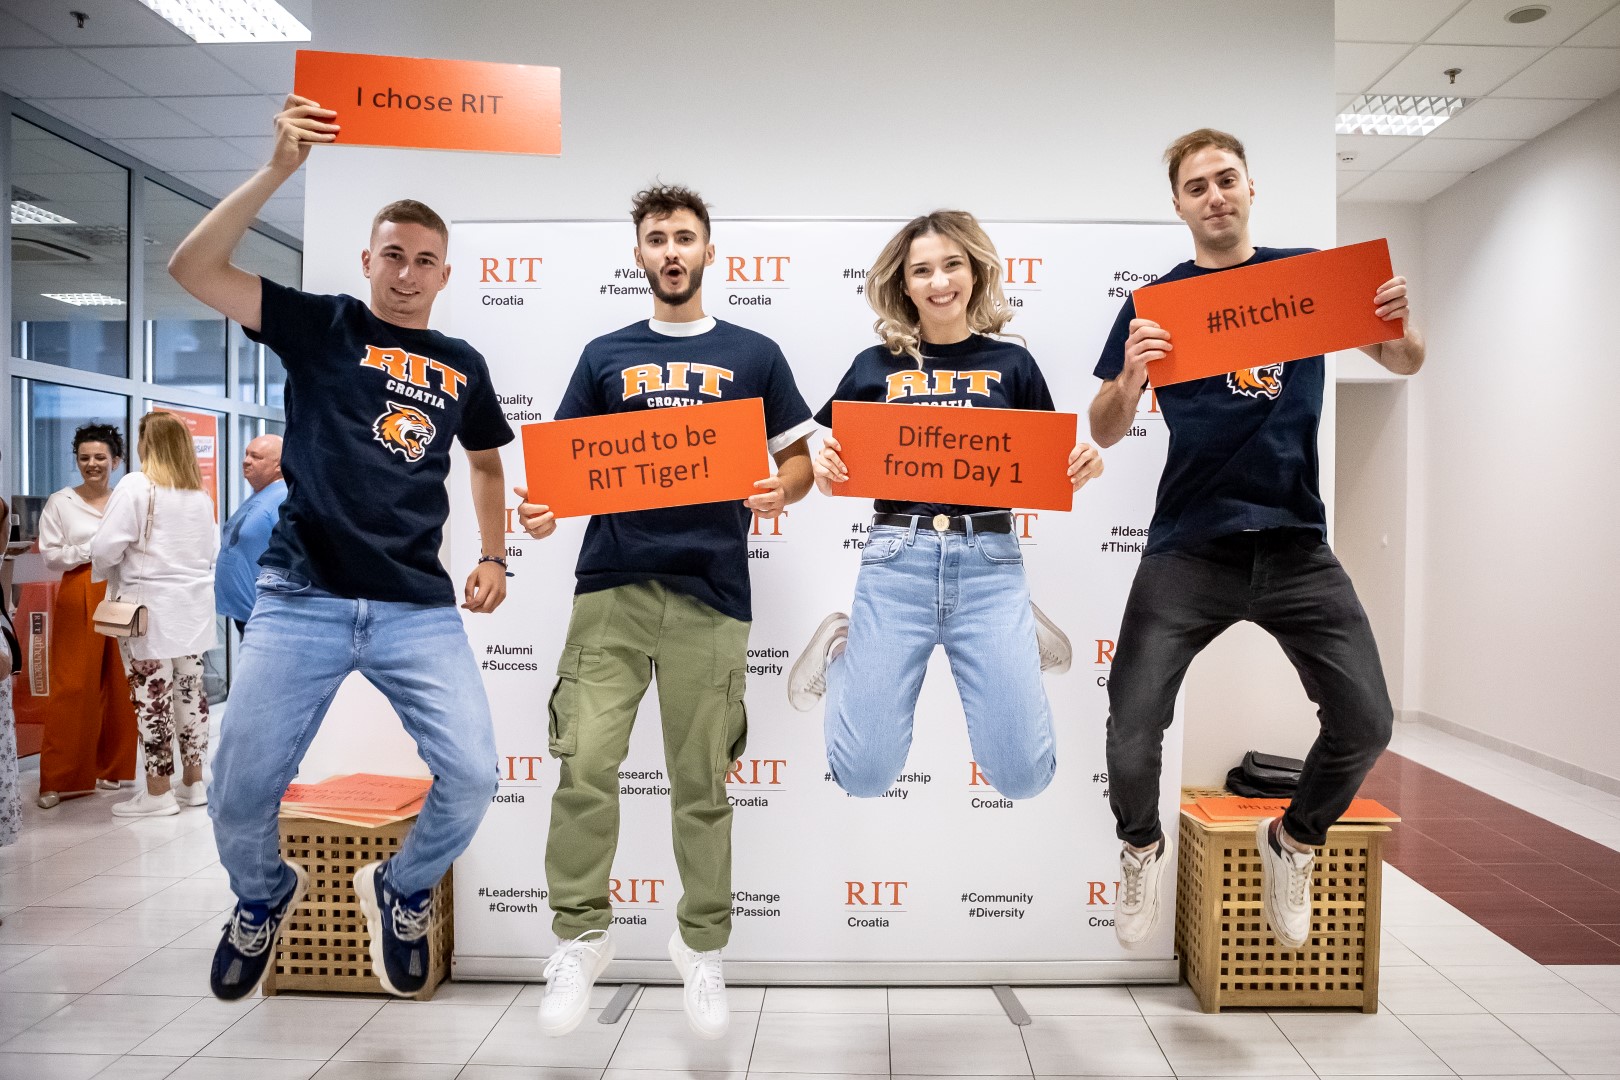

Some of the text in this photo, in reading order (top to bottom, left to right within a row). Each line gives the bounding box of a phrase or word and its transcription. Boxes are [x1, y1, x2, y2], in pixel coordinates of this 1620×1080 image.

[357, 87, 504, 115] I chose RIT
[480, 257, 542, 282] RIT
[614, 268, 647, 280] #Valu
[726, 256, 790, 282] RIT
[1004, 258, 1043, 284] IT
[600, 284, 653, 296] #Teamwo
[482, 294, 524, 306] Croatia
[729, 294, 772, 306] Croatia
[1207, 295, 1315, 333] #Ritchie
[360, 344, 467, 401] RIT
[621, 362, 733, 401] RIT
[886, 369, 1001, 403] RIT
[386, 379, 445, 410] CROATIA
[496, 394, 533, 407] Quality
[506, 410, 542, 421] cation
[571, 424, 717, 460] Proud to be
[899, 425, 1012, 453] Different
[588, 456, 710, 491] RIT Tiger!
[883, 454, 1023, 487] from Day 1
[750, 510, 789, 536] IT
[1111, 525, 1149, 537] #Ideas
[1101, 541, 1148, 553] #Thinki
[748, 548, 770, 560] atia
[486, 644, 533, 655] #Alumni
[746, 648, 789, 659] ovation
[482, 660, 538, 671] #Success
[746, 664, 783, 676] tegrity
[500, 756, 542, 781] IT
[618, 769, 663, 781] esearch
[492, 793, 525, 804] roatia
[726, 796, 768, 807] Croatia
[971, 797, 1013, 809] Croatia
[478, 887, 548, 900] #Leadership
[730, 891, 780, 904] #Change
[845, 881, 908, 906] RIT
[961, 892, 1034, 905] #Community
[489, 902, 538, 914] #Growth
[730, 907, 780, 918] #Passion
[969, 907, 1025, 920] #Diversity
[847, 917, 889, 928] Croatia
[1088, 917, 1115, 928] Croa
